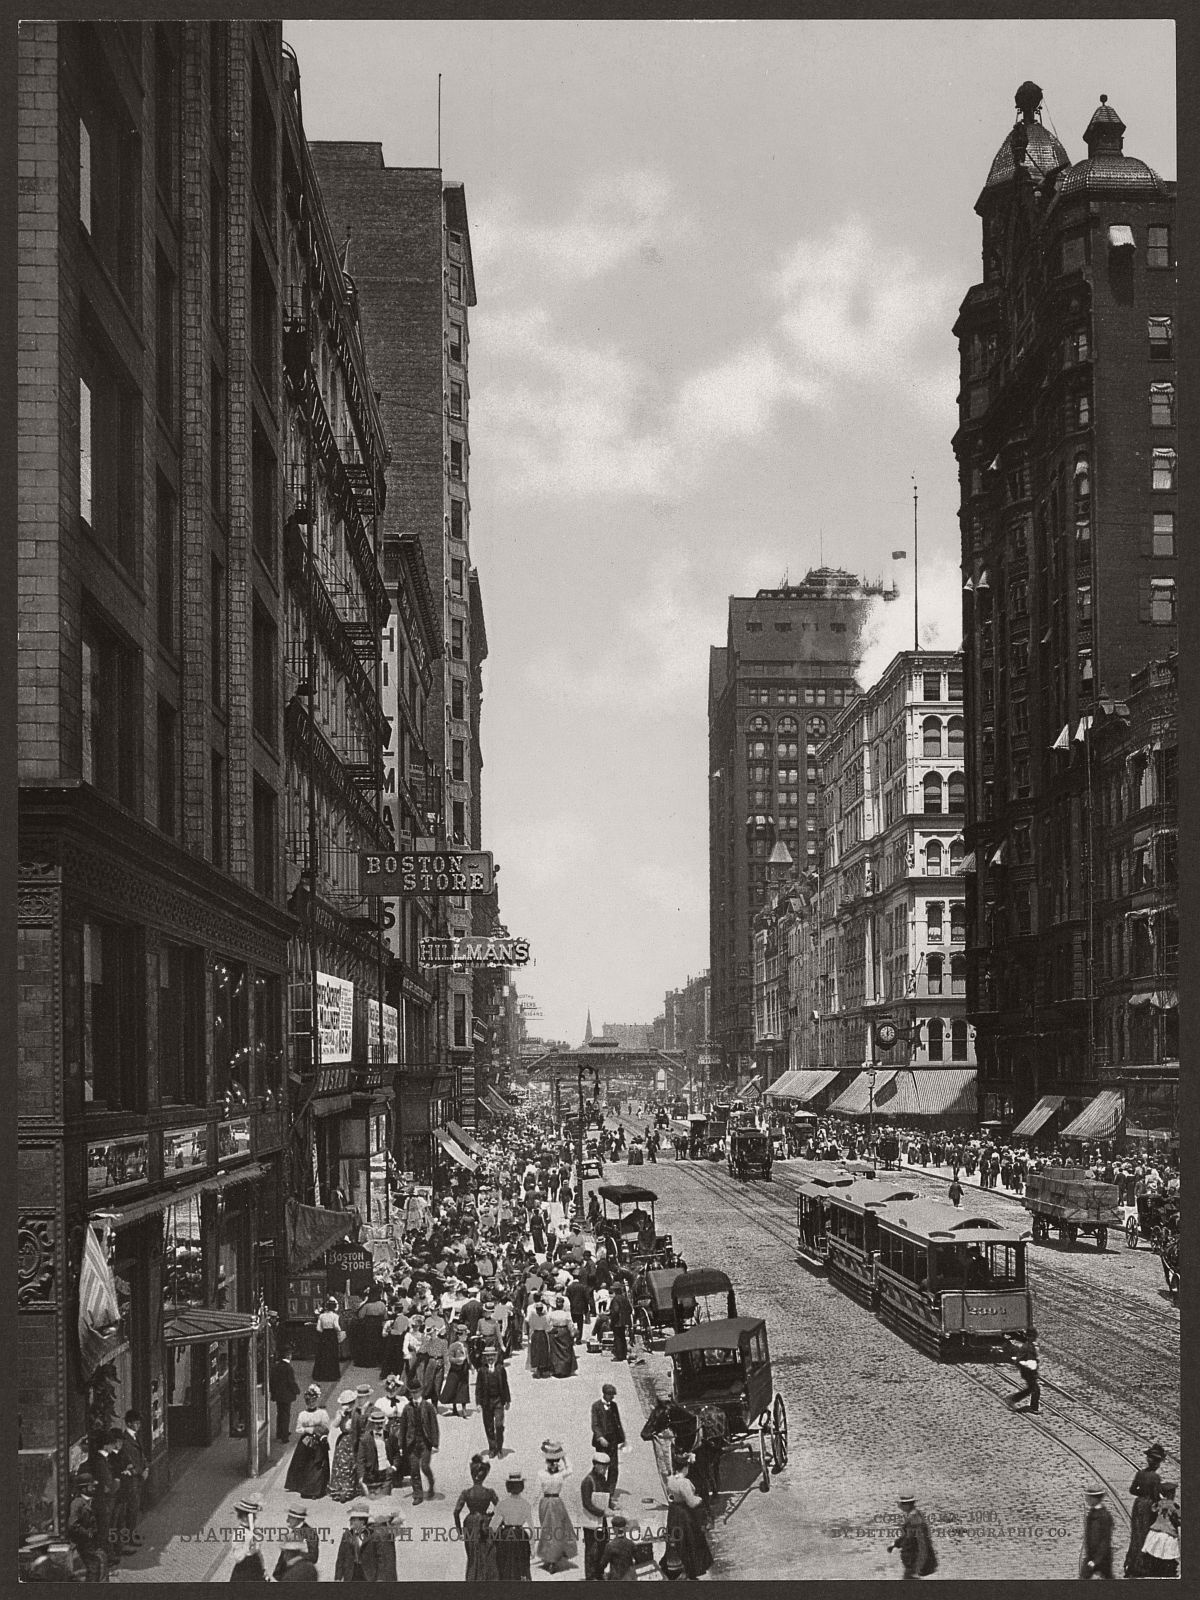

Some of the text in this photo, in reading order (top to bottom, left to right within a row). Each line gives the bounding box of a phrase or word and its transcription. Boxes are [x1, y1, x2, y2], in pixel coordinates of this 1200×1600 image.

[366, 856, 463, 874] BOSTON
[403, 873, 484, 891] STORE
[420, 943, 528, 961] HILLMAN'S
[328, 1251, 364, 1264] BOSTON
[341, 1261, 372, 1271] STORE
